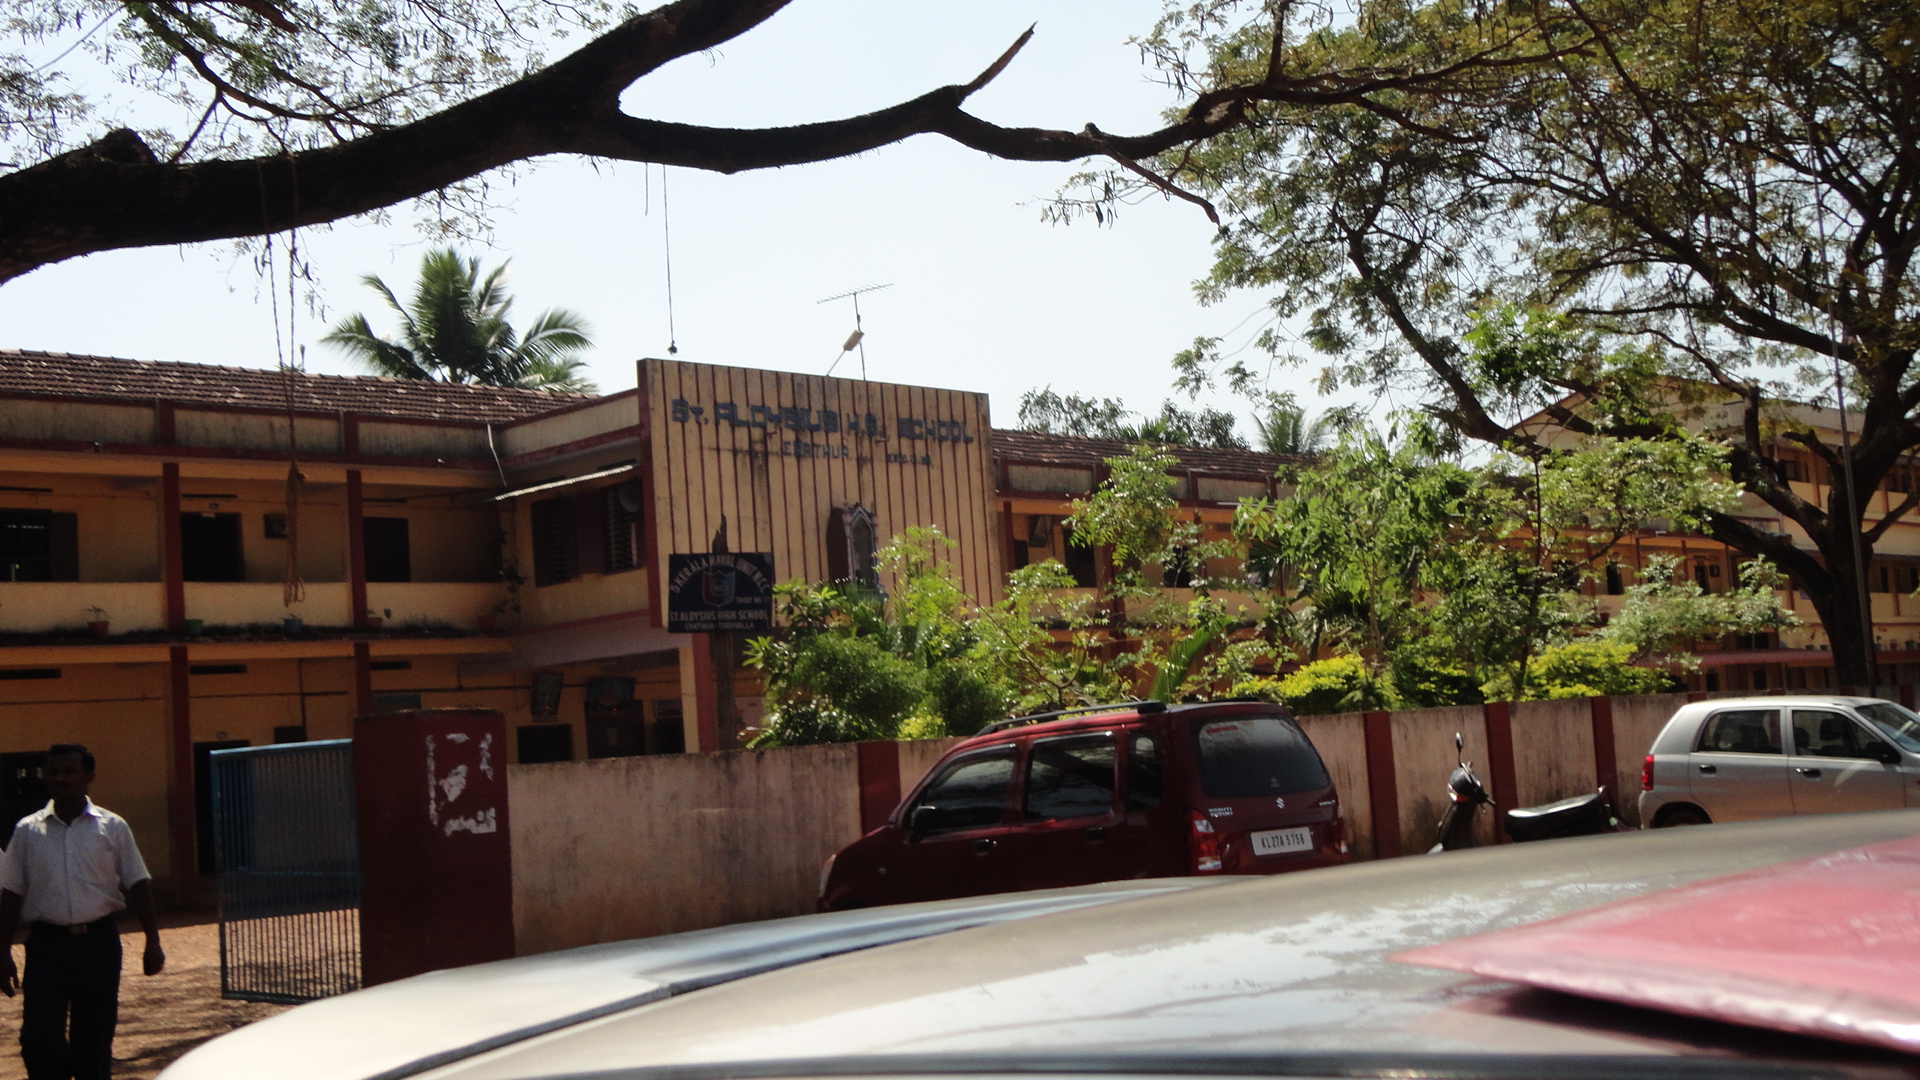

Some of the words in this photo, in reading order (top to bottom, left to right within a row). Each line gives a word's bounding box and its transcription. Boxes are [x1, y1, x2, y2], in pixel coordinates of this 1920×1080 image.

[715, 401, 839, 434] ALOYSIUS
[898, 416, 974, 444] SCHOOL
[673, 556, 709, 588] KERALA
[738, 609, 769, 621] SCHOOL
